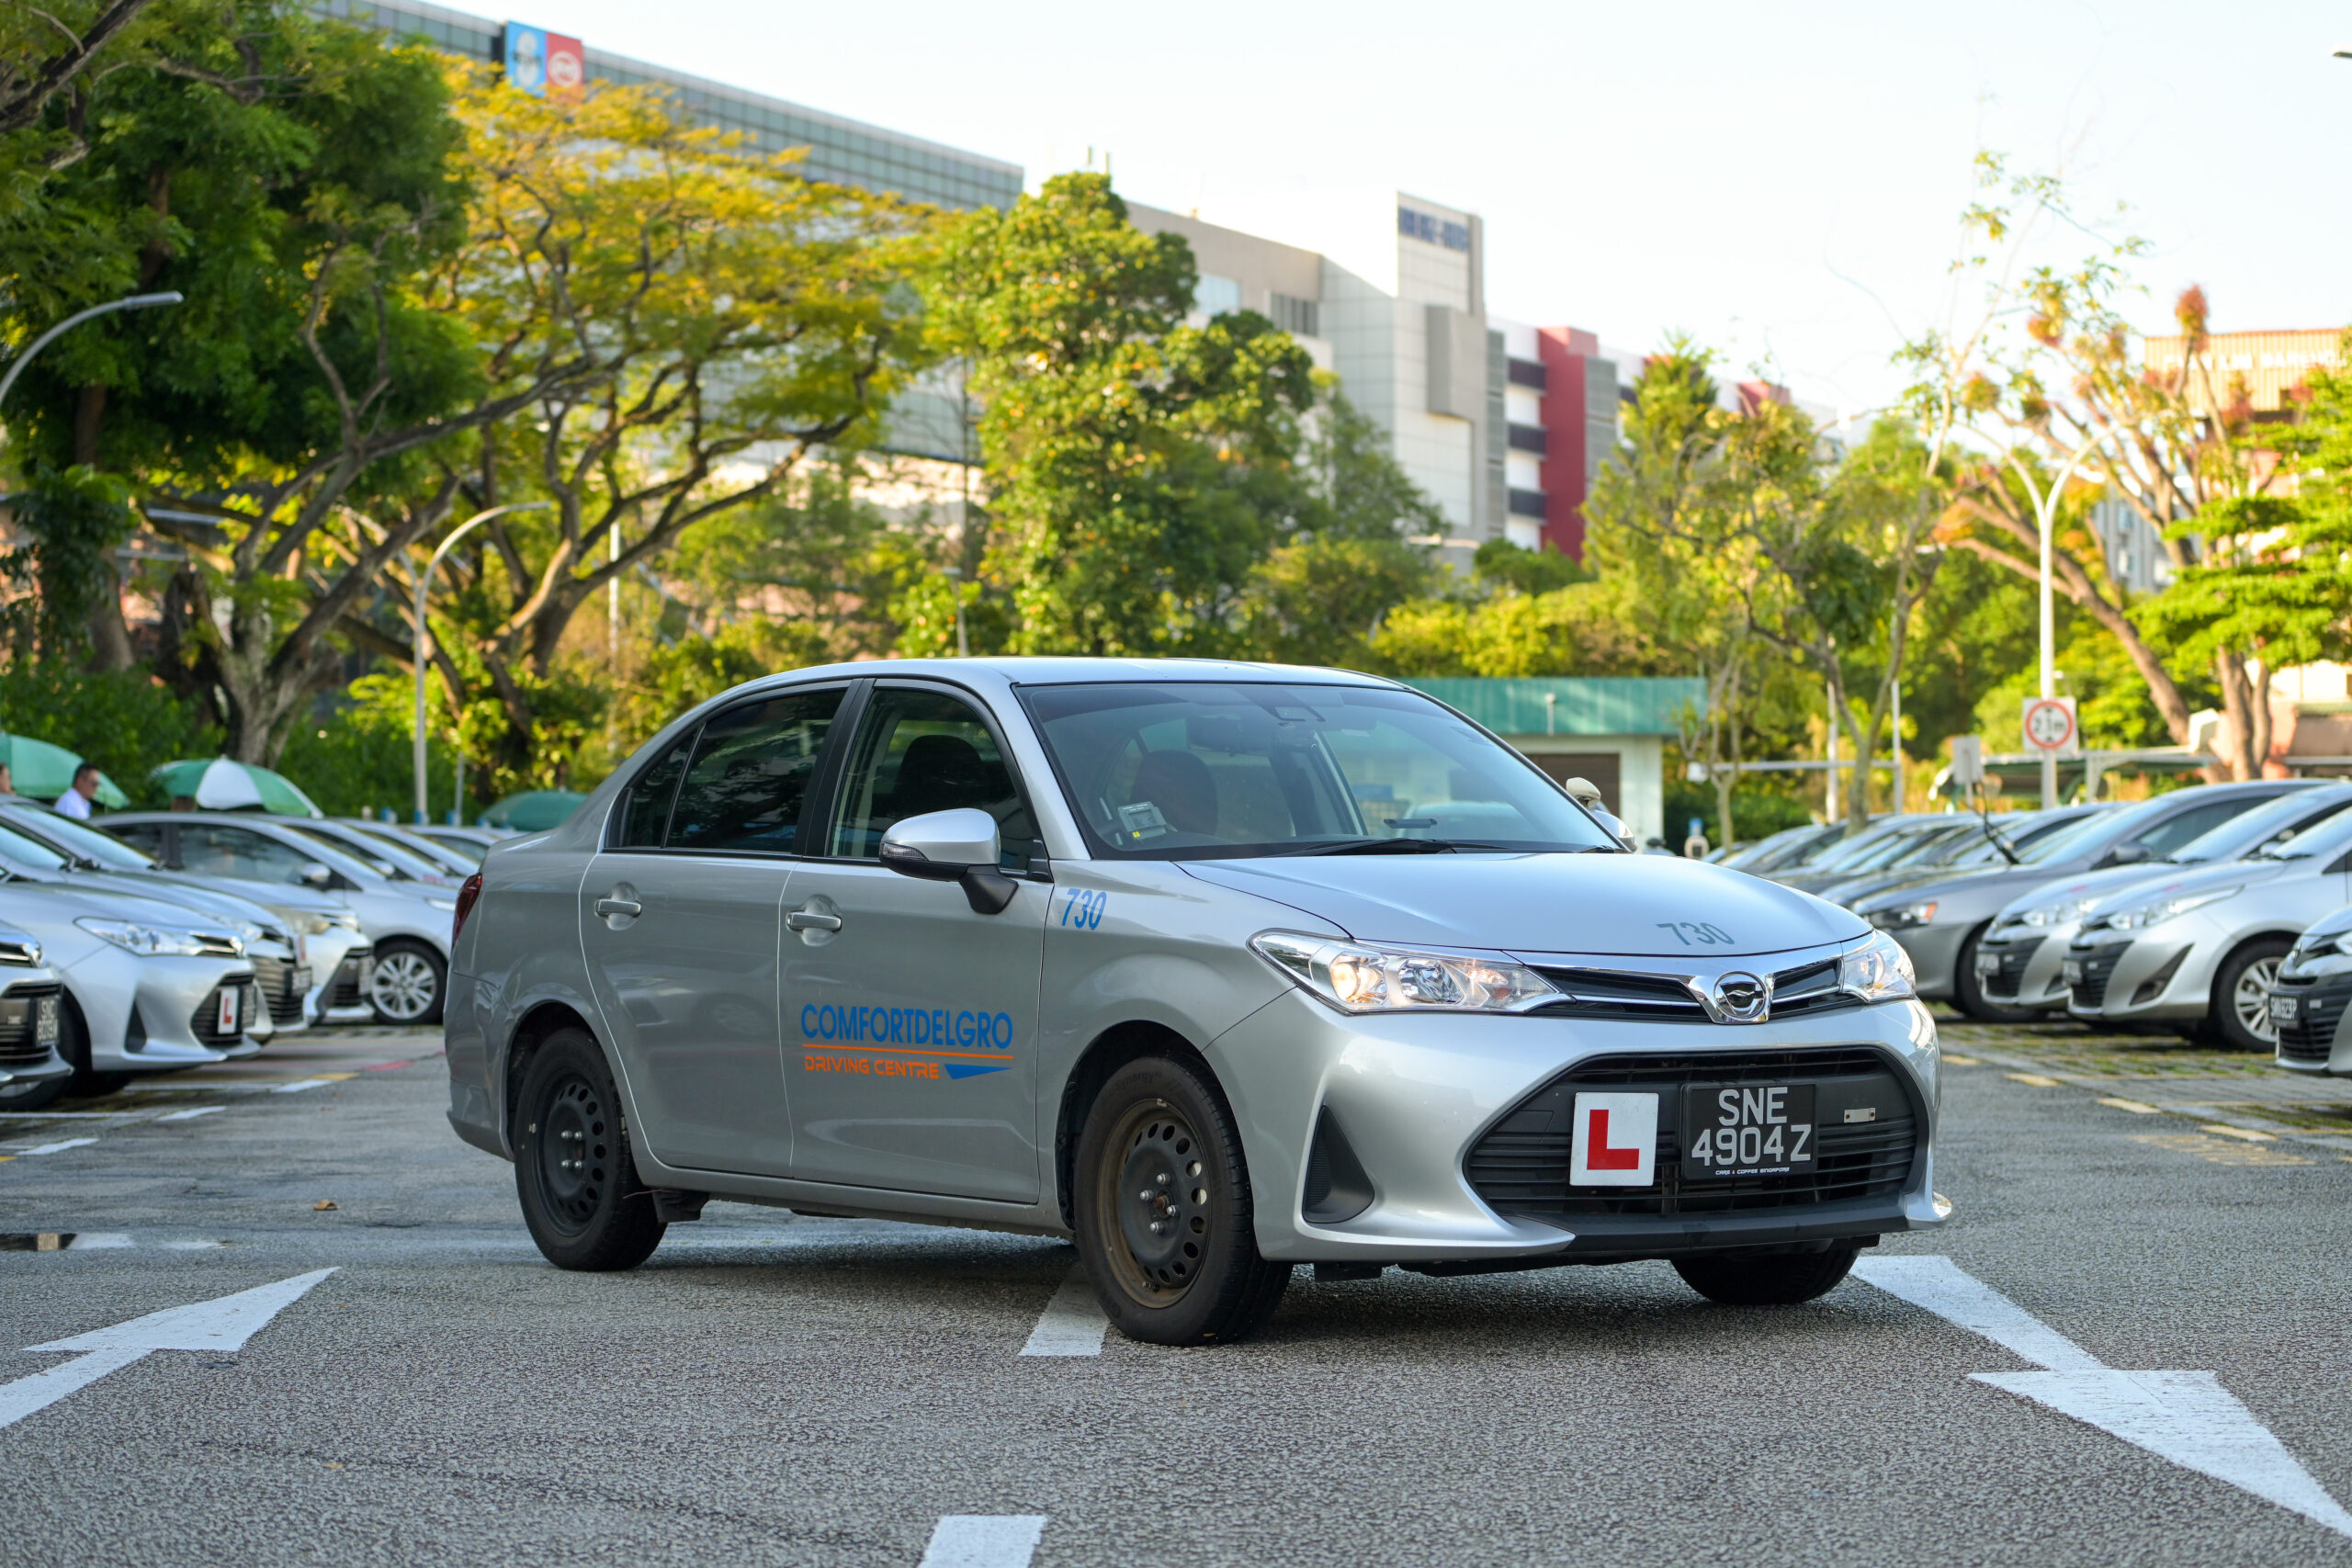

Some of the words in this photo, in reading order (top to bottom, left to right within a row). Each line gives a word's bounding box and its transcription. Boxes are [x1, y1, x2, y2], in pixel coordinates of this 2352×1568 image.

[1061, 887, 1106, 930] 730
[1655, 922, 1736, 945] 730
[801, 1004, 1012, 1049] COMFORTDELGRO
[805, 1055, 870, 1075] DRIVING
[874, 1059, 940, 1079] CENTRE
[1718, 1087, 1788, 1126] SNE
[1587, 1109, 1640, 1170] L
[1691, 1124, 1812, 1166] 4904Z
